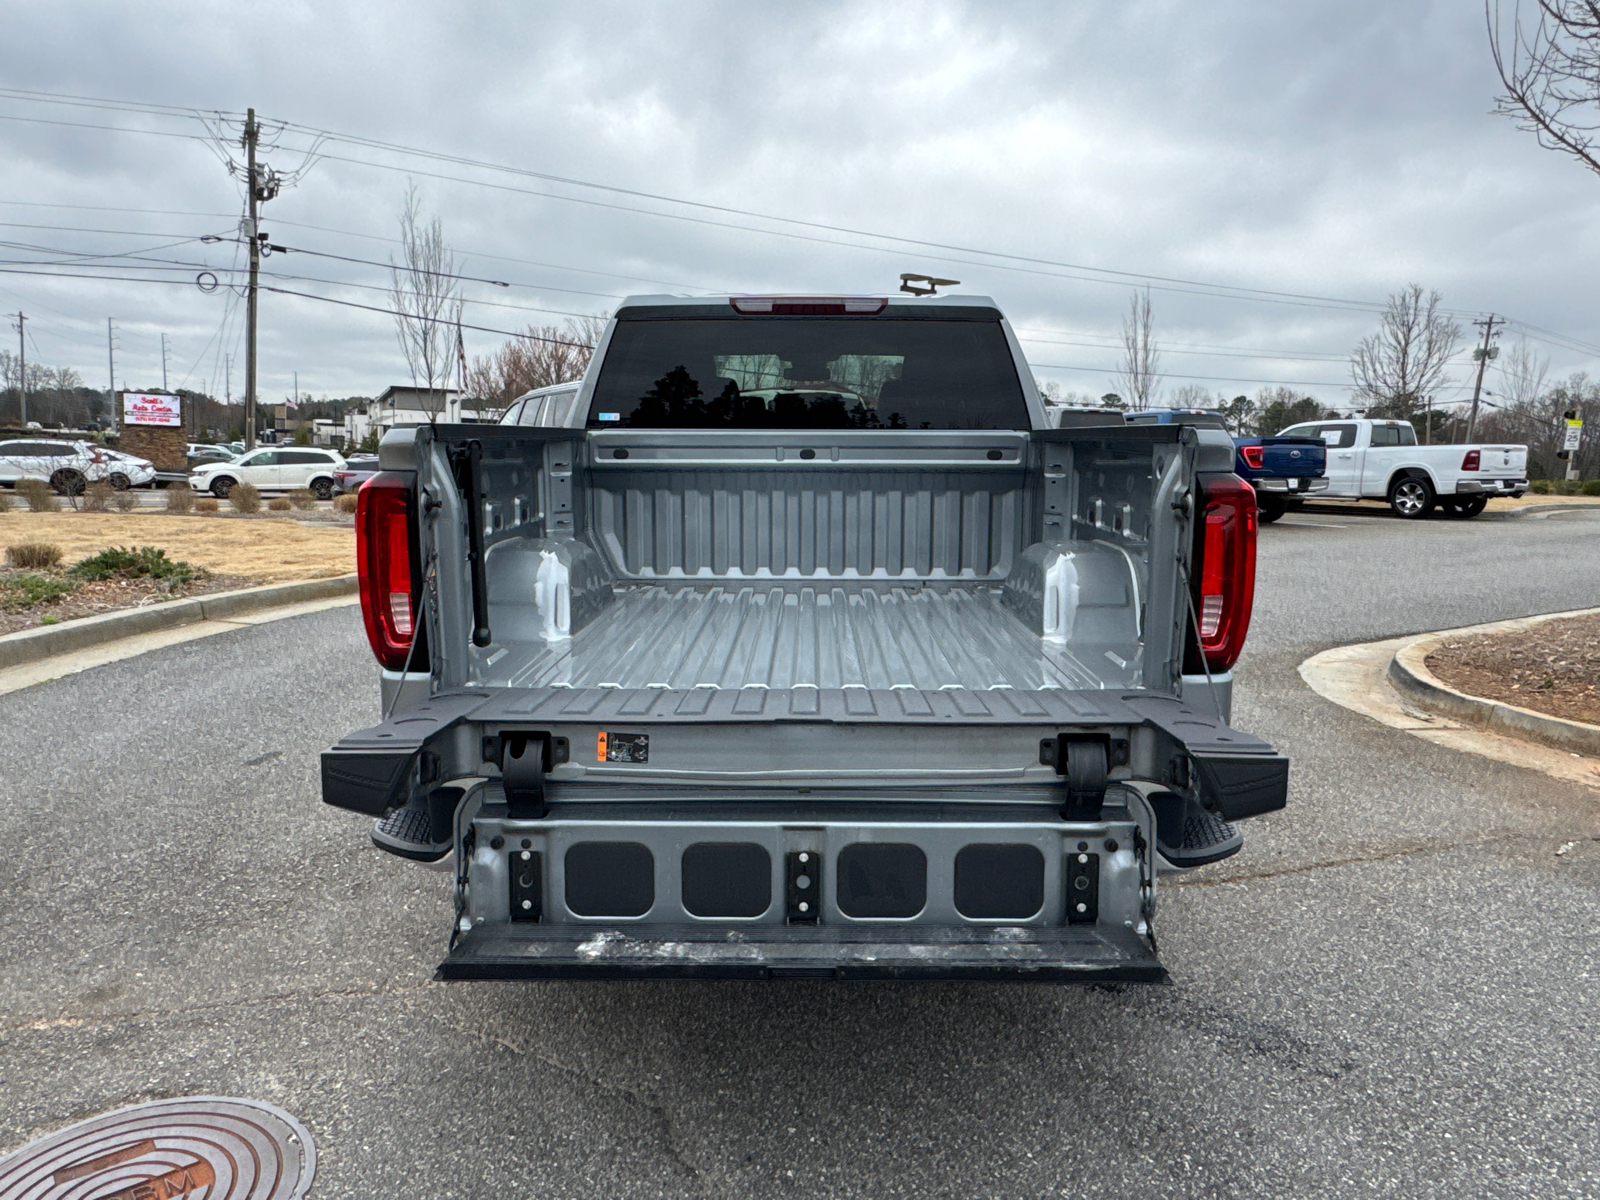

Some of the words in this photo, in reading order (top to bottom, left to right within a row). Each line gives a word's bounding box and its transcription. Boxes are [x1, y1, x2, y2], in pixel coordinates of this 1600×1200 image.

[132, 403, 148, 411] Auto
[1567, 434, 1578, 442] 25
[109, 1168, 194, 1200] RM
